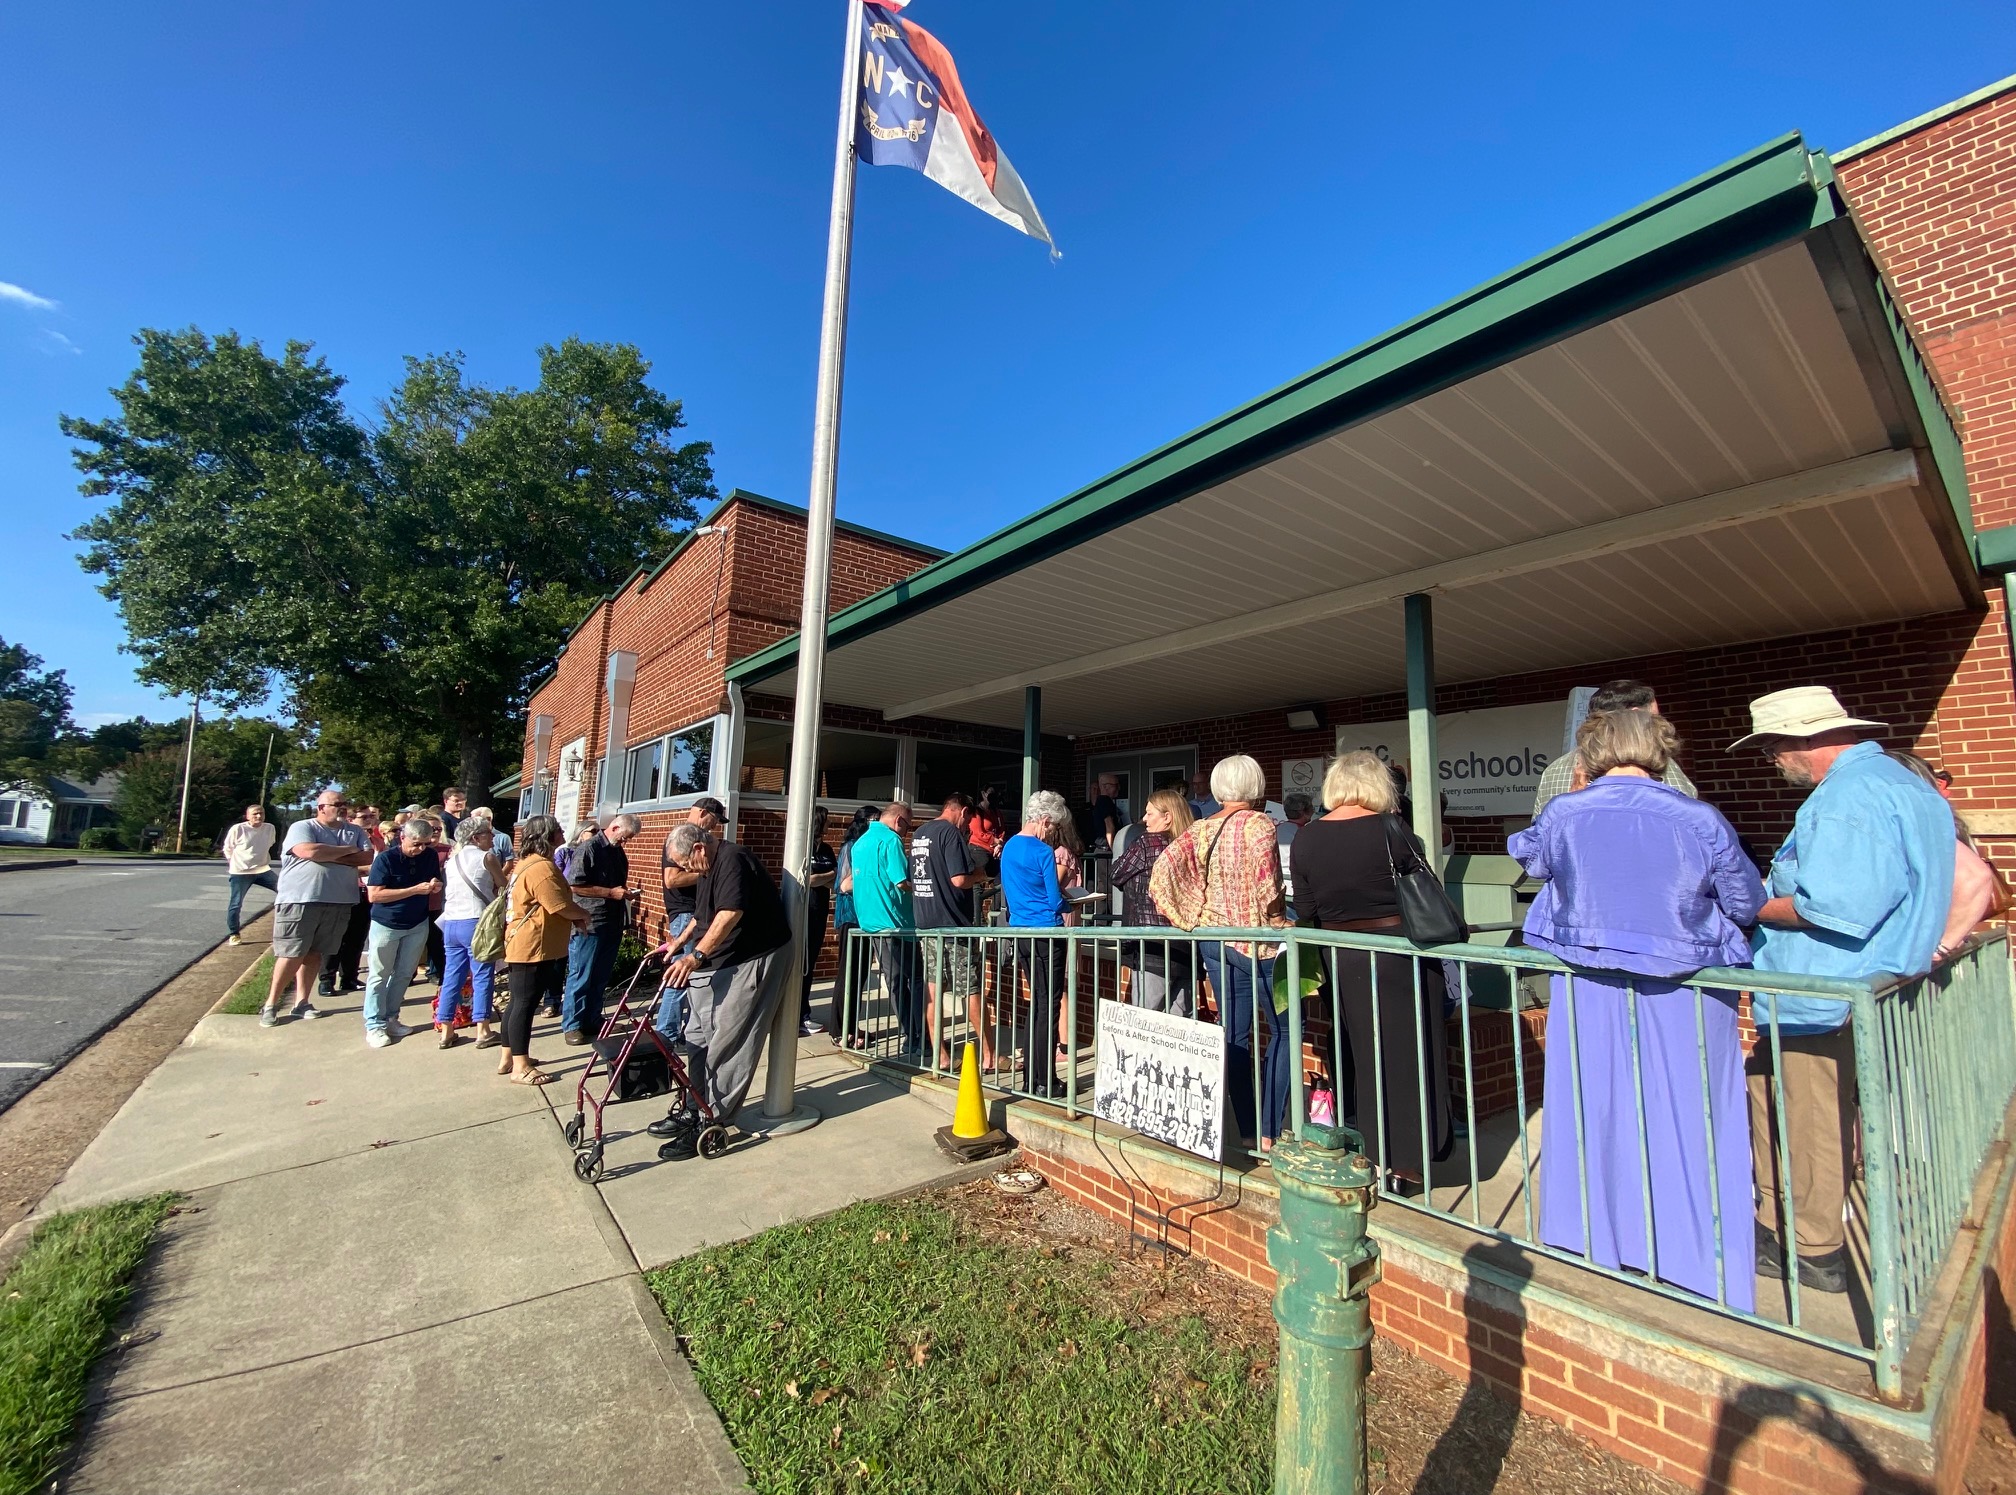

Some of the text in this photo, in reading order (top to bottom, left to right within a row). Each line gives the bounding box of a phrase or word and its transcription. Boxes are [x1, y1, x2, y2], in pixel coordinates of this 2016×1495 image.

[864, 51, 933, 108] N C
[866, 121, 885, 138] APRIL
[1439, 747, 1548, 780] schools
[1442, 784, 1537, 796] Every community's future
[1102, 1022, 1220, 1061] Before & After School Child Care
